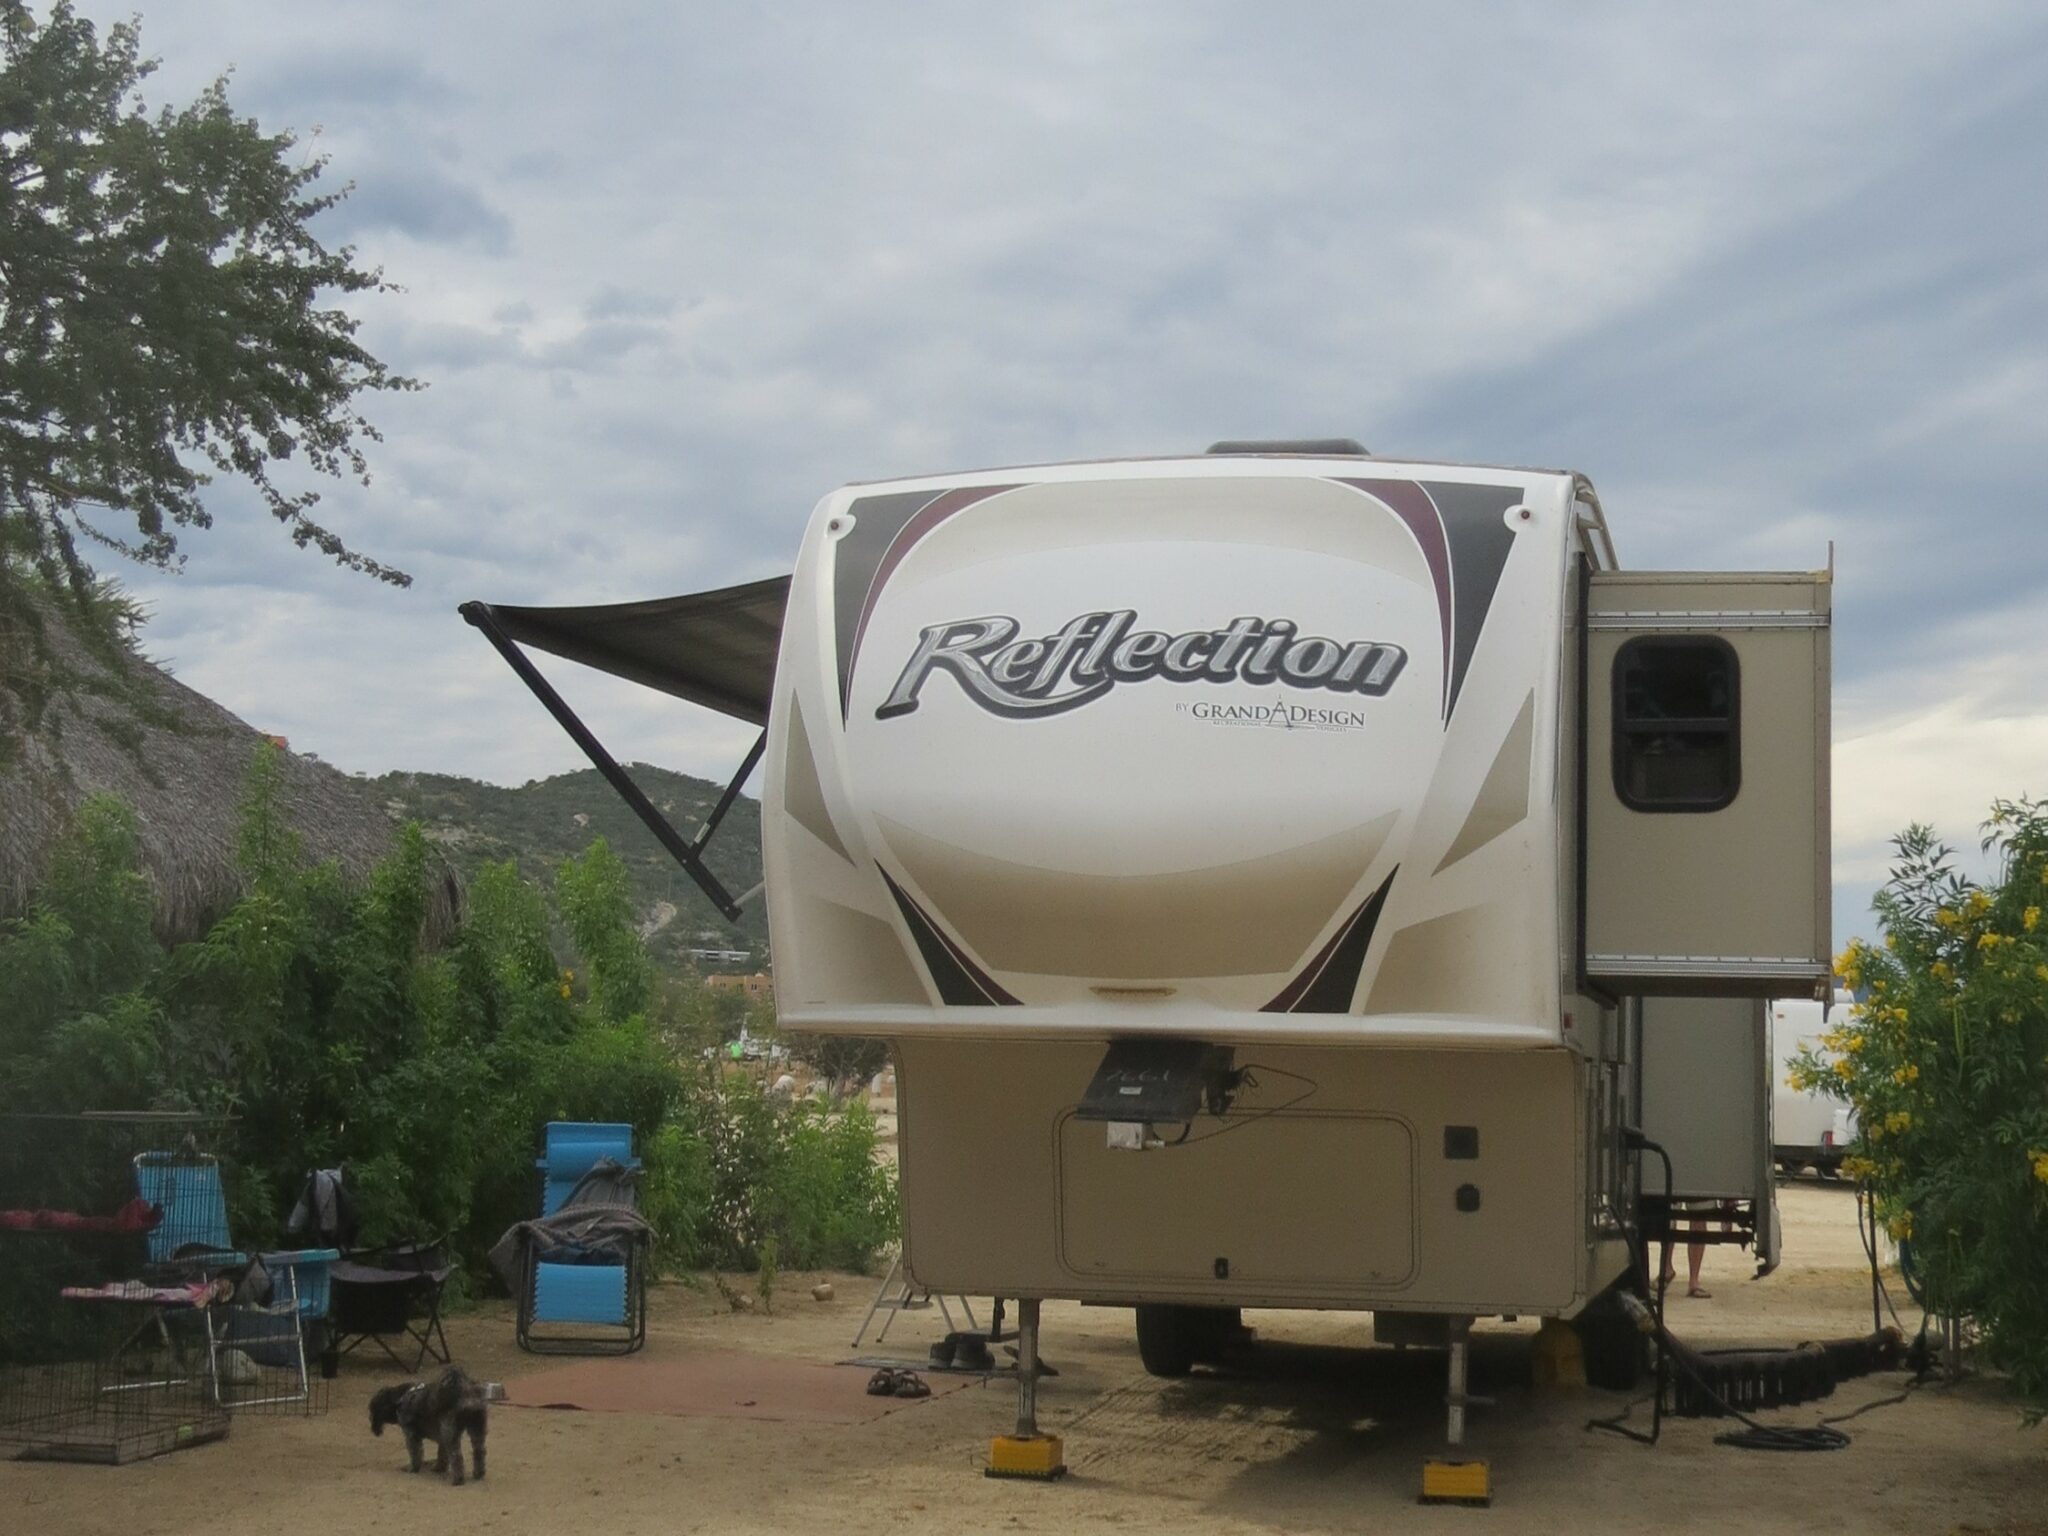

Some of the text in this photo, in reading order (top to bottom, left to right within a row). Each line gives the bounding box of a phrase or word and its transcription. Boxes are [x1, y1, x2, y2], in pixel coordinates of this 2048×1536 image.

[875, 609, 1408, 720] Reflection
[1175, 702, 1366, 726] BY GRAND DESIGN
